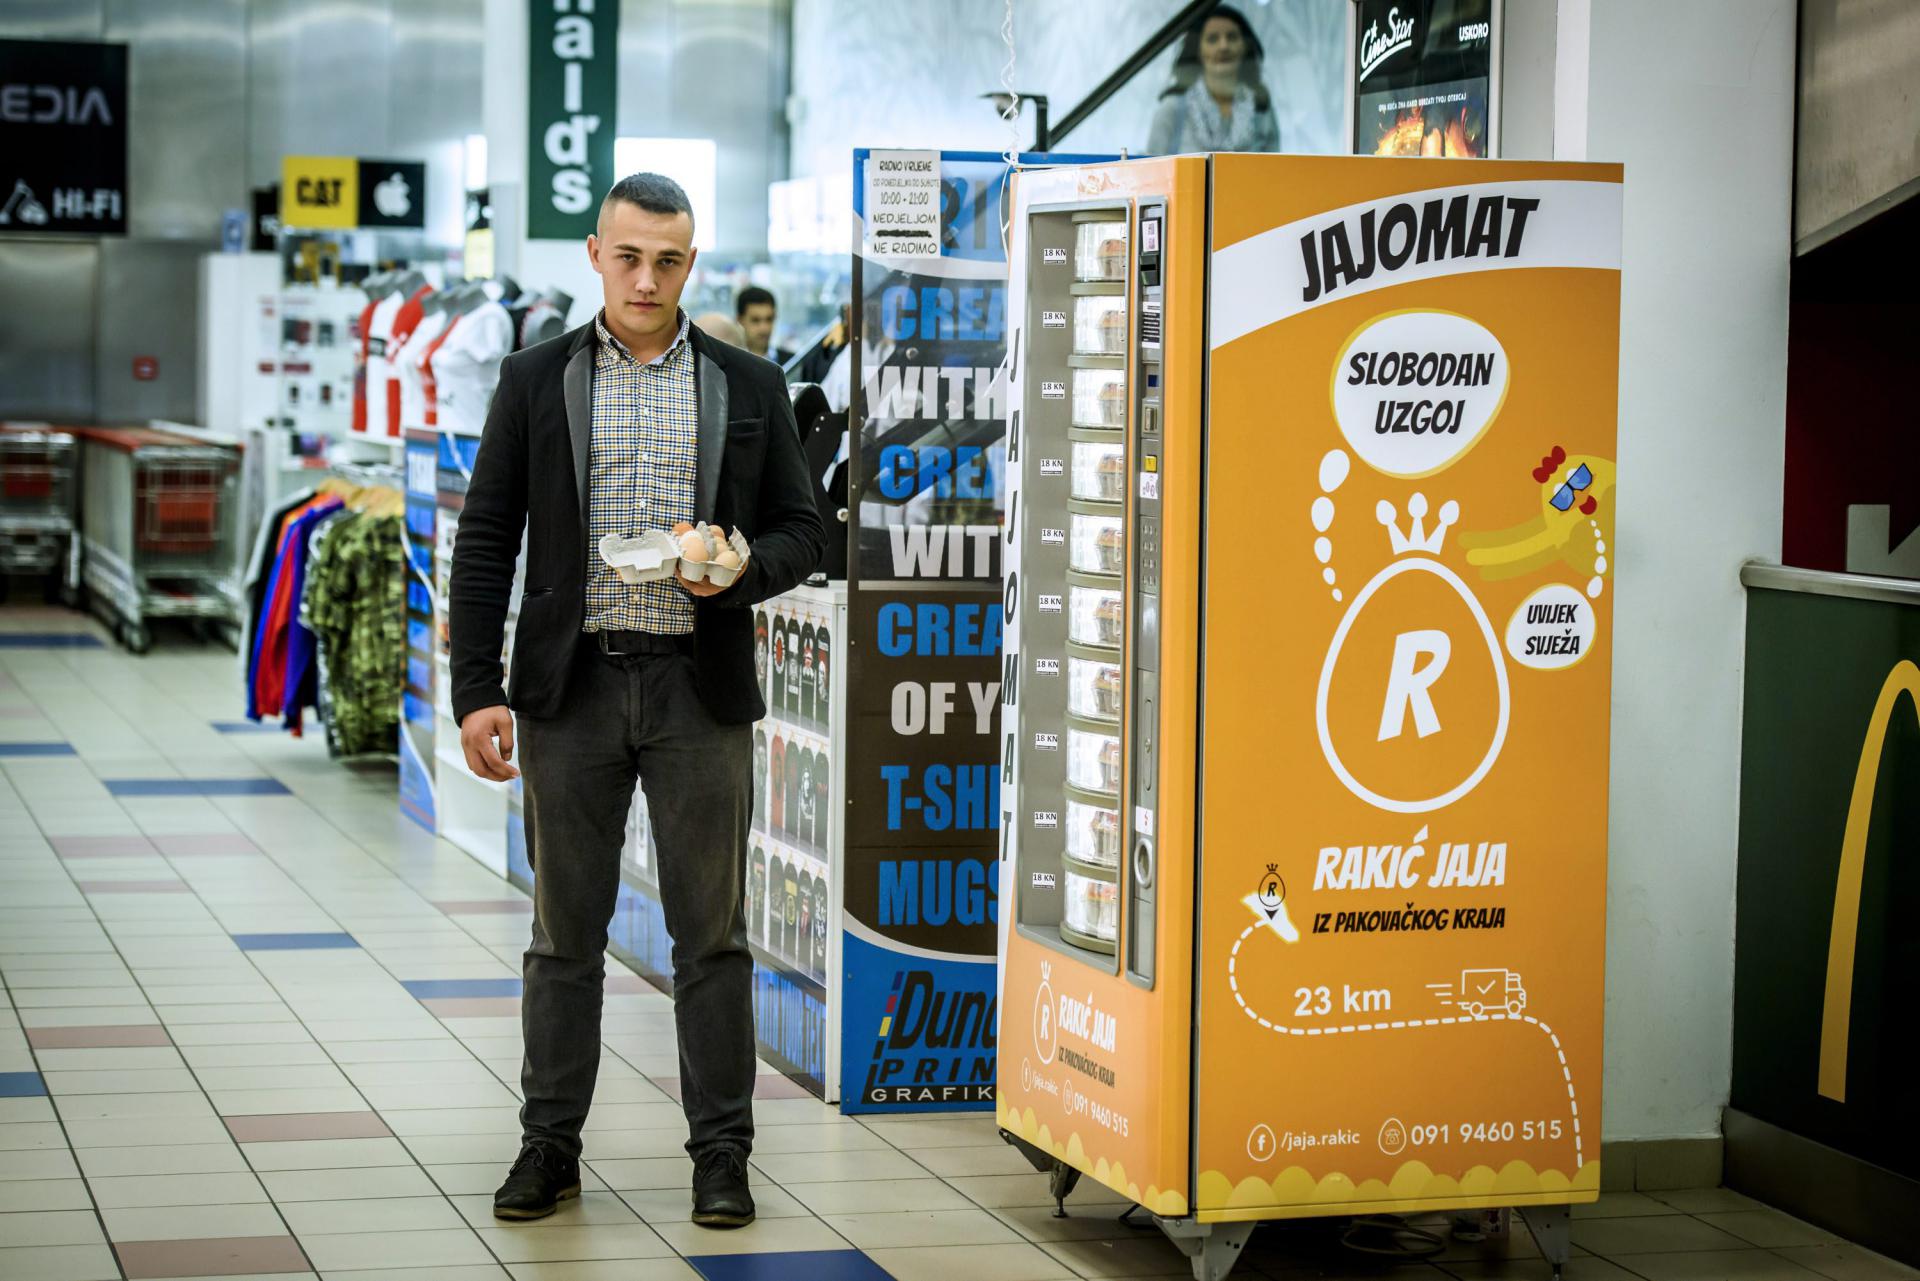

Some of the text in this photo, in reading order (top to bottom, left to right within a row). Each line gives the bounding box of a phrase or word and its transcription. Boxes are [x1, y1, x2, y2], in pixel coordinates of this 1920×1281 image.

[1361, 6, 1414, 69] CineStar
[1458, 22, 1489, 42] USKORO
[544, 0, 600, 215] ald's
[880, 161, 932, 171] RADNO VRIJEME
[53, 186, 121, 220] HI-FI
[297, 177, 343, 207] CAT
[881, 192, 901, 205] 10:00
[909, 192, 928, 205] 21:00
[873, 213, 936, 224] NEDJELJOM
[874, 242, 937, 254] NE RADIMO
[1301, 195, 1540, 302] JAJOMAT
[1044, 312, 1065, 320] 18 KN
[1347, 351, 1495, 387] SLOBODAN
[864, 366, 1007, 419] WITH
[1375, 400, 1465, 434] UZGOJ
[889, 525, 1004, 577] WIT
[1001, 328, 1020, 862] JAJOMAT
[1526, 604, 1578, 624] UVIJEK
[1524, 629, 1580, 655] SVJEŽA
[1377, 629, 1451, 742] R
[891, 681, 956, 735] OF
[1313, 824, 1507, 890] RAKIĆ JAJA
[1267, 882, 1277, 897] R
[1312, 902, 1505, 934] IZ PAKOVAČKOG KRAJA
[1293, 984, 1391, 1017] 23 km
[1040, 1004, 1050, 1041] R
[1058, 991, 1116, 1053] RAKIĆ JAJA
[1058, 1046, 1064, 1062] IZ
[1098, 1067, 1116, 1088] KRAJA
[870, 1086, 993, 1102] GRAFIK
[1074, 1093, 1128, 1138] 091 9460 515
[1411, 1119, 1562, 1146] 091 9460 515
[1280, 1129, 1360, 1151] /jaja.rakic
